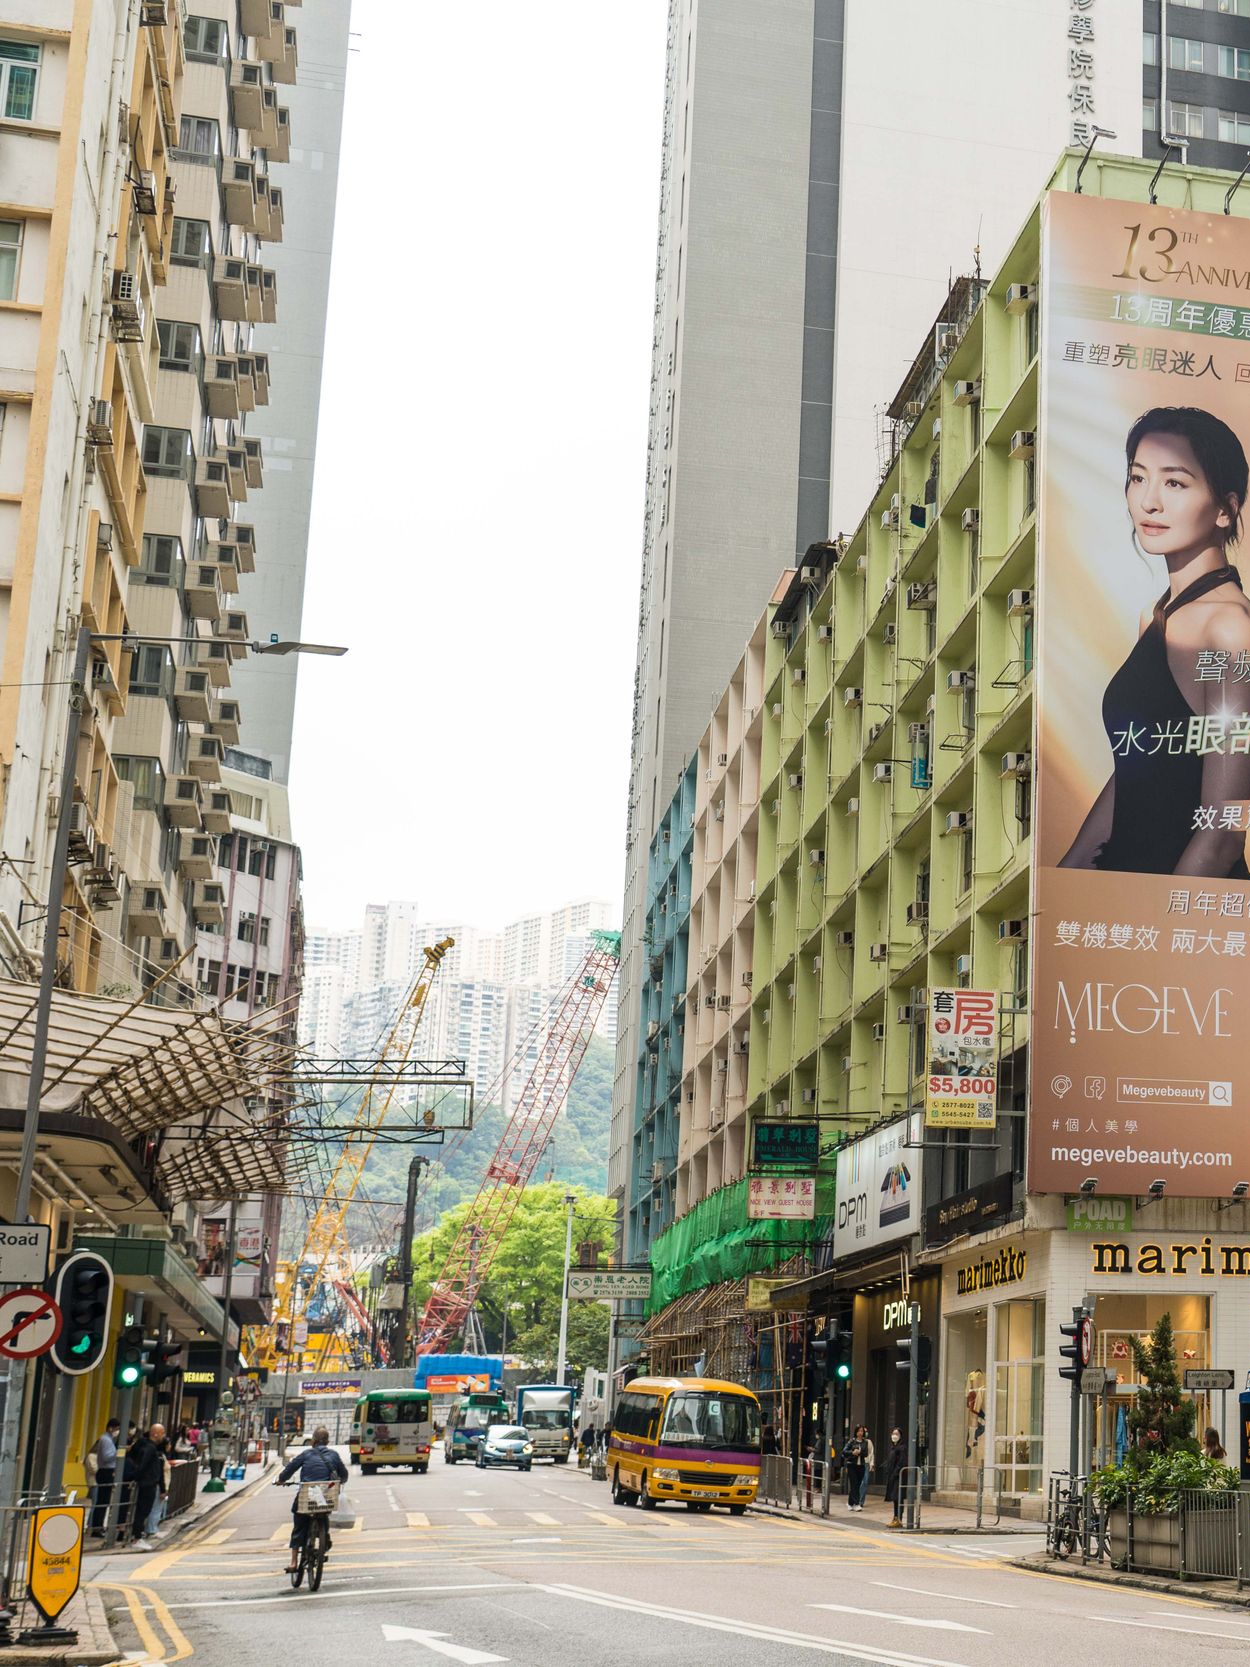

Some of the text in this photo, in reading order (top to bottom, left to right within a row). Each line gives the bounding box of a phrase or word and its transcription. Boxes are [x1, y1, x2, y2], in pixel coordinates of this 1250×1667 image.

[1062, 340, 1222, 381] 重塑亮眼迷人
[1054, 920, 1160, 952] 雙機雙效
[1054, 980, 1233, 1040] MEGEVE
[929, 1077, 995, 1096] $5,800
[1122, 1083, 1206, 1101] Megevebeauty
[1051, 1144, 1232, 1168] megevebeauty.com
[838, 1192, 867, 1230] DPM
[1073, 1199, 1126, 1221] POAD
[0, 1232, 38, 1246] Road
[957, 1246, 1026, 1295] marimekko
